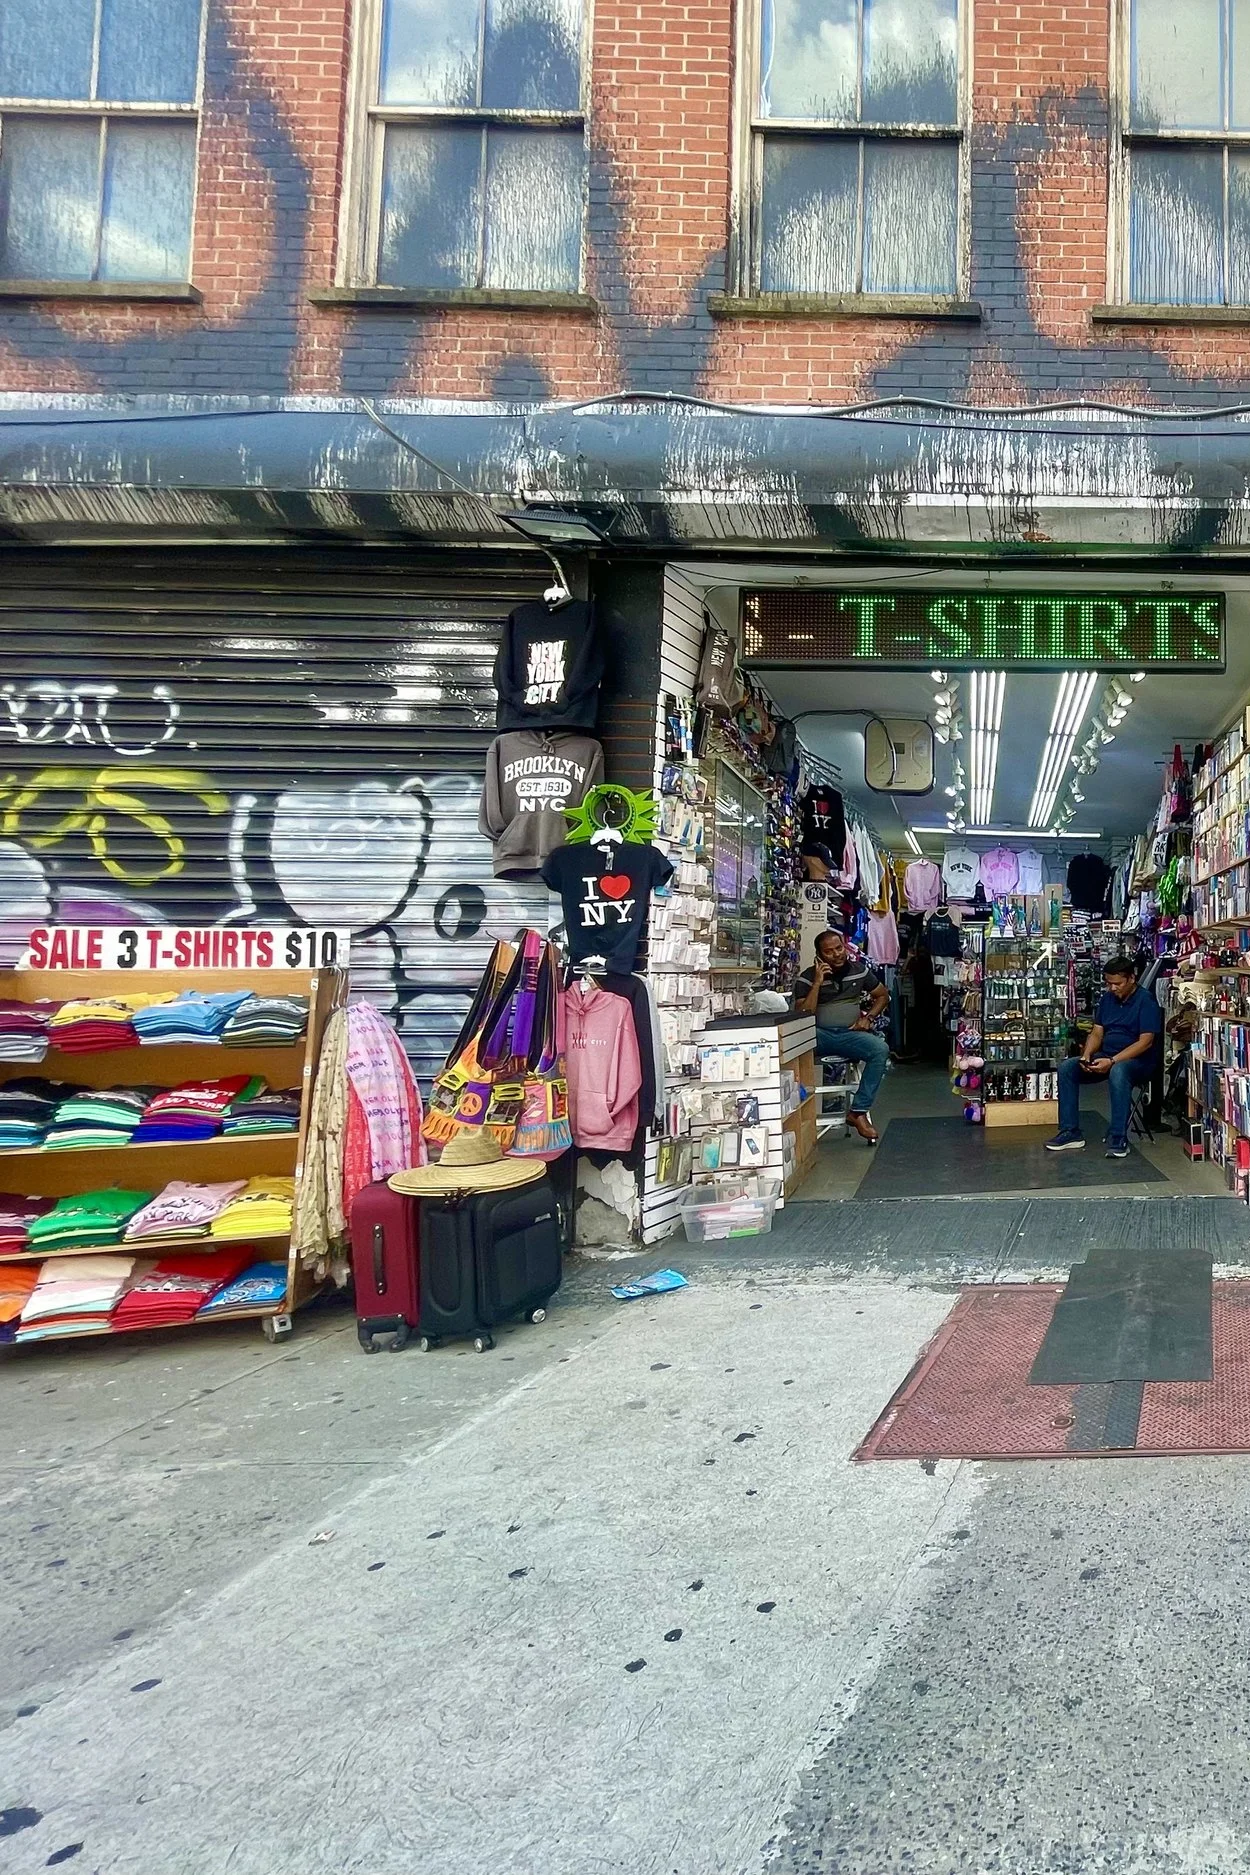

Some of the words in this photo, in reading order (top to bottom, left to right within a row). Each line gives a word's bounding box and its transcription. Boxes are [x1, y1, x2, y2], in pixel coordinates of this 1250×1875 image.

[839, 598, 1219, 660] T-SHIRTS
[529, 640, 567, 663] NEW
[526, 661, 566, 684] YORK
[524, 682, 563, 704] CITY
[504, 755, 586, 784] BROOKLYN
[544, 781, 566, 793] 1631
[519, 798, 566, 812] NYC
[582, 877, 599, 901] I
[29, 930, 103, 969] SALE
[117, 930, 139, 969] 3
[147, 931, 274, 968] T-SHIRTS
[285, 931, 338, 968] $10
[187, 1099, 226, 1110] YORK
